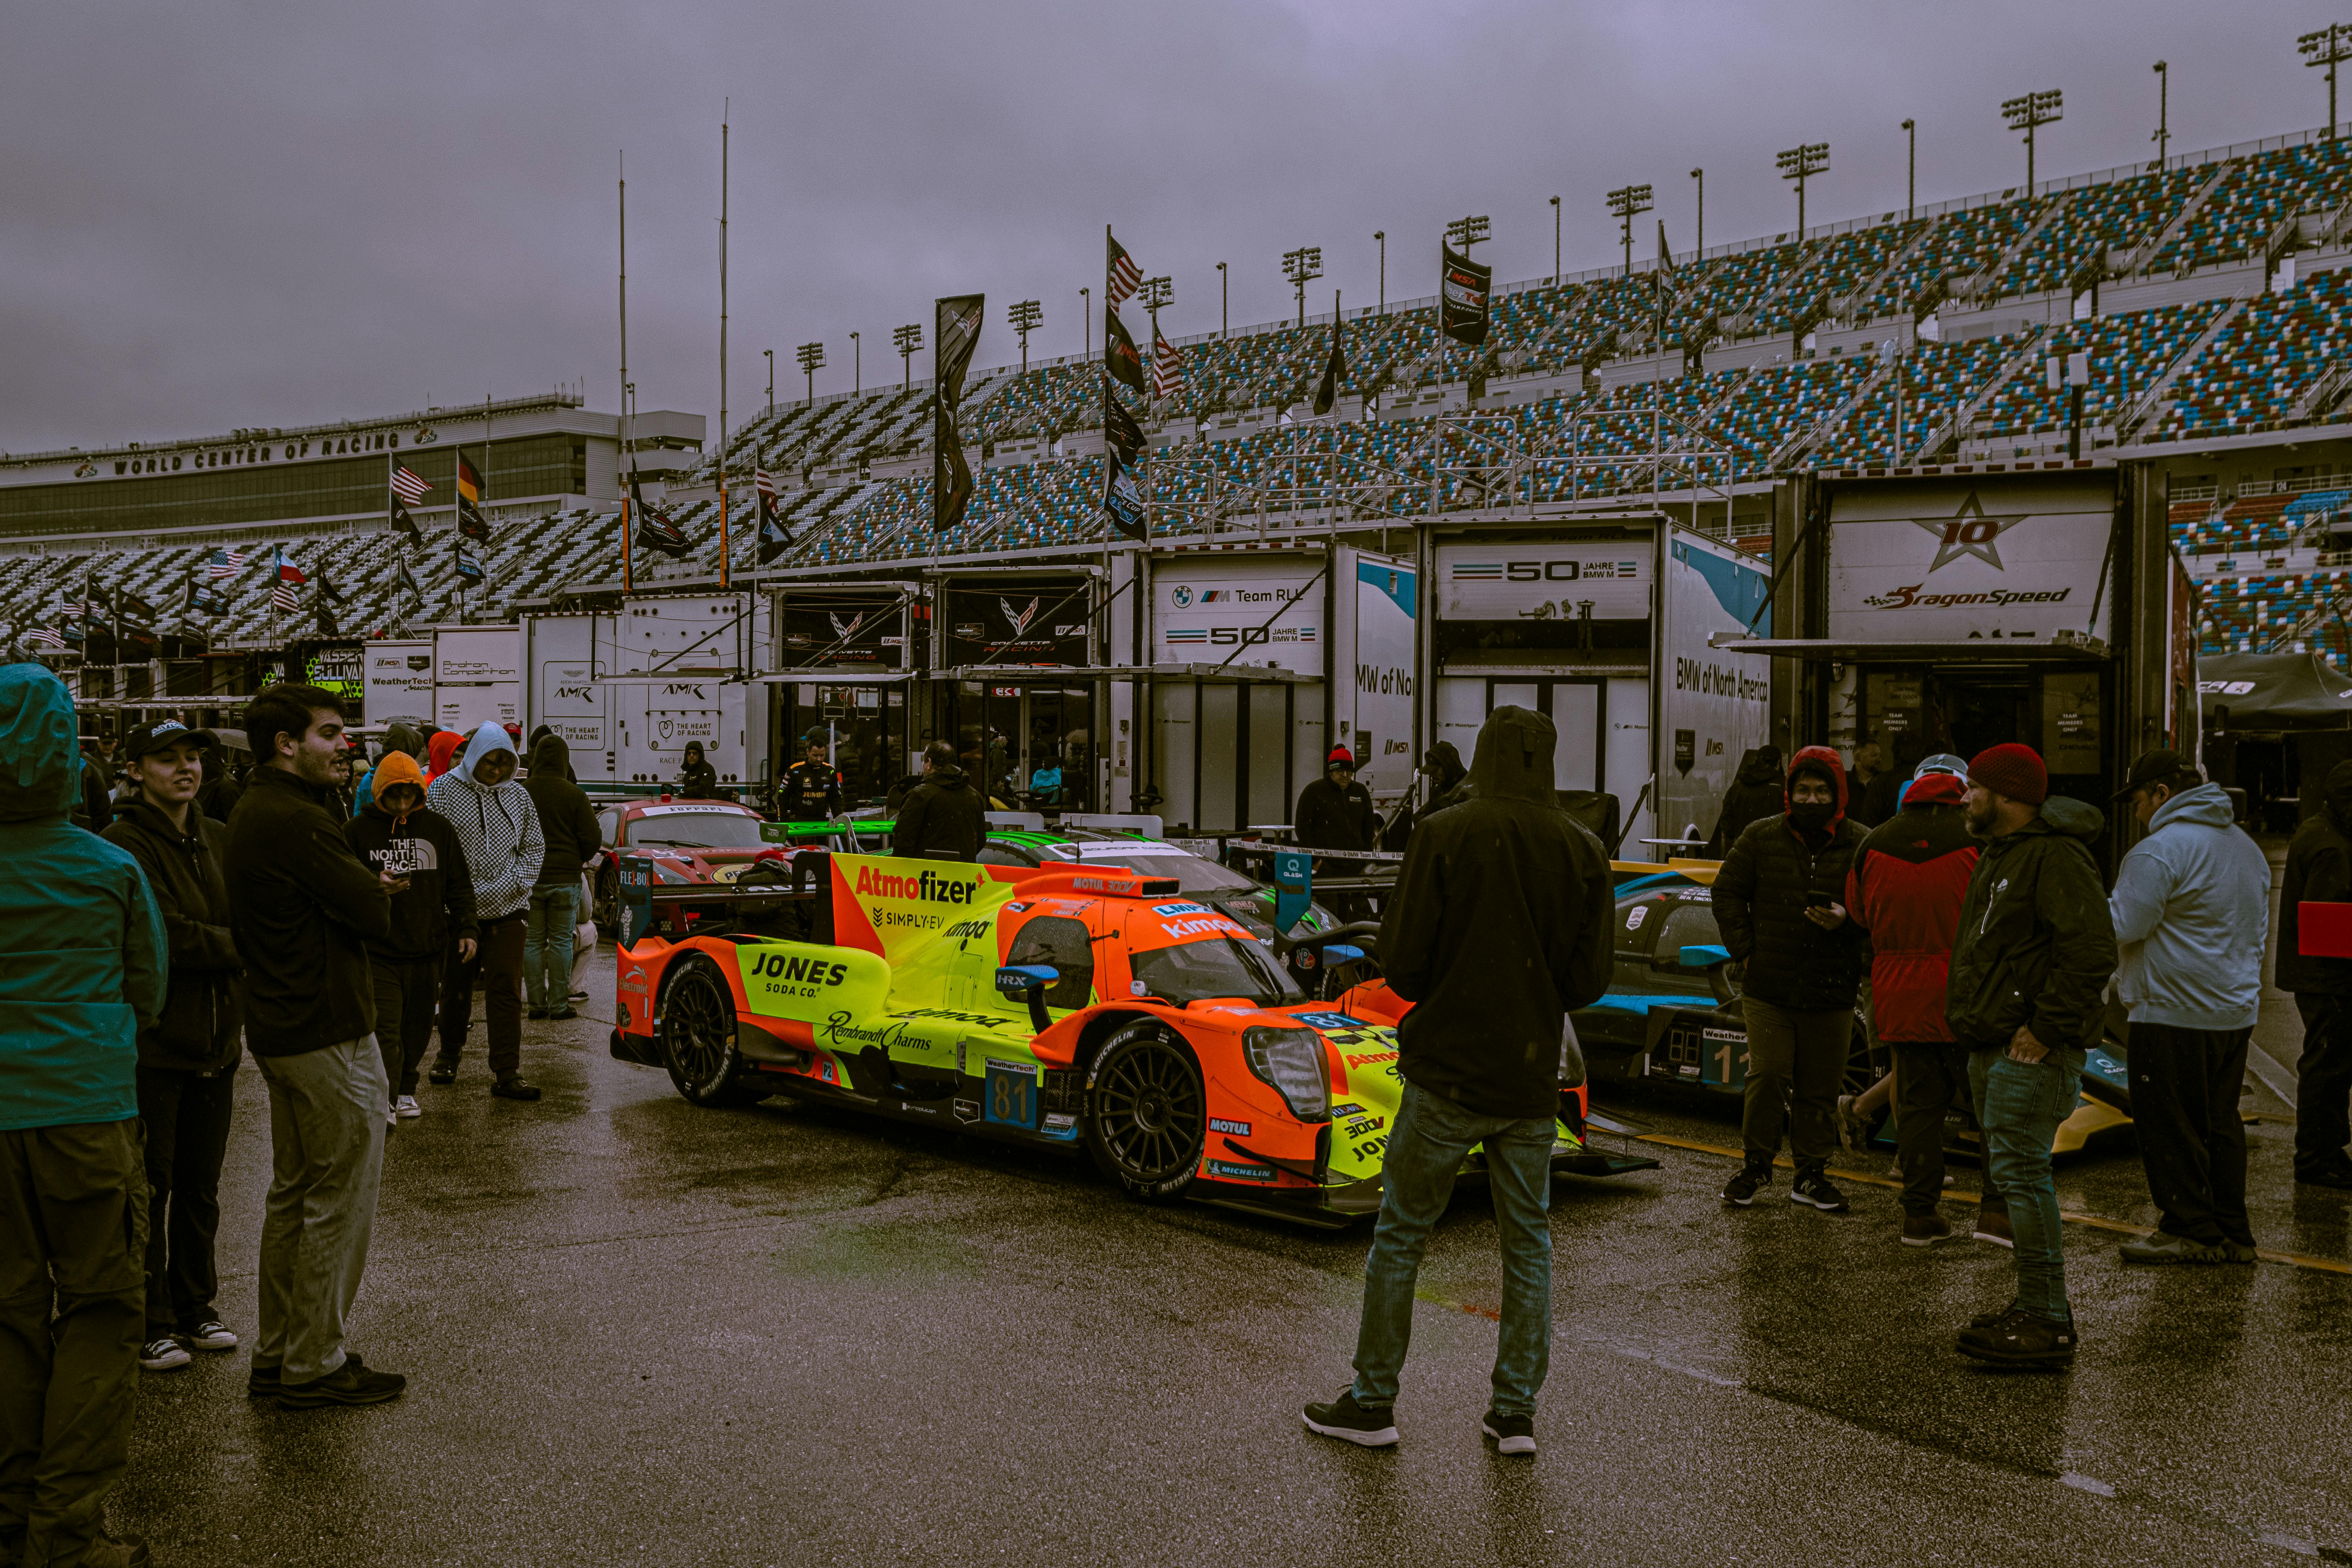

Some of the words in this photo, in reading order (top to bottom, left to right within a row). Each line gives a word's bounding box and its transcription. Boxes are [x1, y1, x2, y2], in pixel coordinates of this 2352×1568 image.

[115, 455, 182, 475] WORLD
[194, 446, 270, 468] CENTER
[285, 442, 309, 459] OF
[322, 433, 398, 455] RACING
[2275, 481, 2288, 492] 124
[1940, 519, 2000, 545] 10
[1507, 561, 1579, 580] 50
[1236, 590, 1271, 602] Team
[1277, 589, 1303, 601] RLL
[1211, 627, 1269, 644] 50
[1357, 664, 1378, 693] MW
[1381, 667, 1393, 694] of
[1677, 657, 1701, 692] BMW
[1703, 663, 1712, 694] of
[1713, 664, 1736, 698] North
[1738, 669, 1767, 701] America
[1392, 742, 1409, 753] IMSA
[389, 839, 415, 849] THE
[369, 849, 415, 861] NORTH
[384, 859, 416, 870] FACE
[620, 871, 649, 887] FLEX-BOX
[855, 865, 976, 904] Atmofizer
[1073, 878, 1104, 890] MOTUL
[1108, 881, 1136, 893] 300V
[943, 918, 990, 939] kimoa
[752, 952, 848, 986] JONES
[664, 962, 693, 1000] MICHELIN
[997, 974, 1027, 985] HRX
[766, 982, 795, 995] SODA
[1302, 1014, 1363, 1027] 81
[820, 1011, 882, 1044] Rembrandt
[881, 1022, 931, 1050] Charms
[1705, 1030, 1747, 1040] Weather
[1094, 1029, 1135, 1069] MICHELIN
[823, 1062, 832, 1079] P2
[987, 1060, 1034, 1072] WeatherTech
[700, 1058, 733, 1096] MICHELIN
[994, 1074, 1027, 1122] 81
[1210, 1119, 1249, 1136] MOTUL
[1344, 1116, 1383, 1139] 300V
[1161, 1155, 1203, 1192] MICHELIN
[1222, 1166, 1271, 1177] MICHELIN
